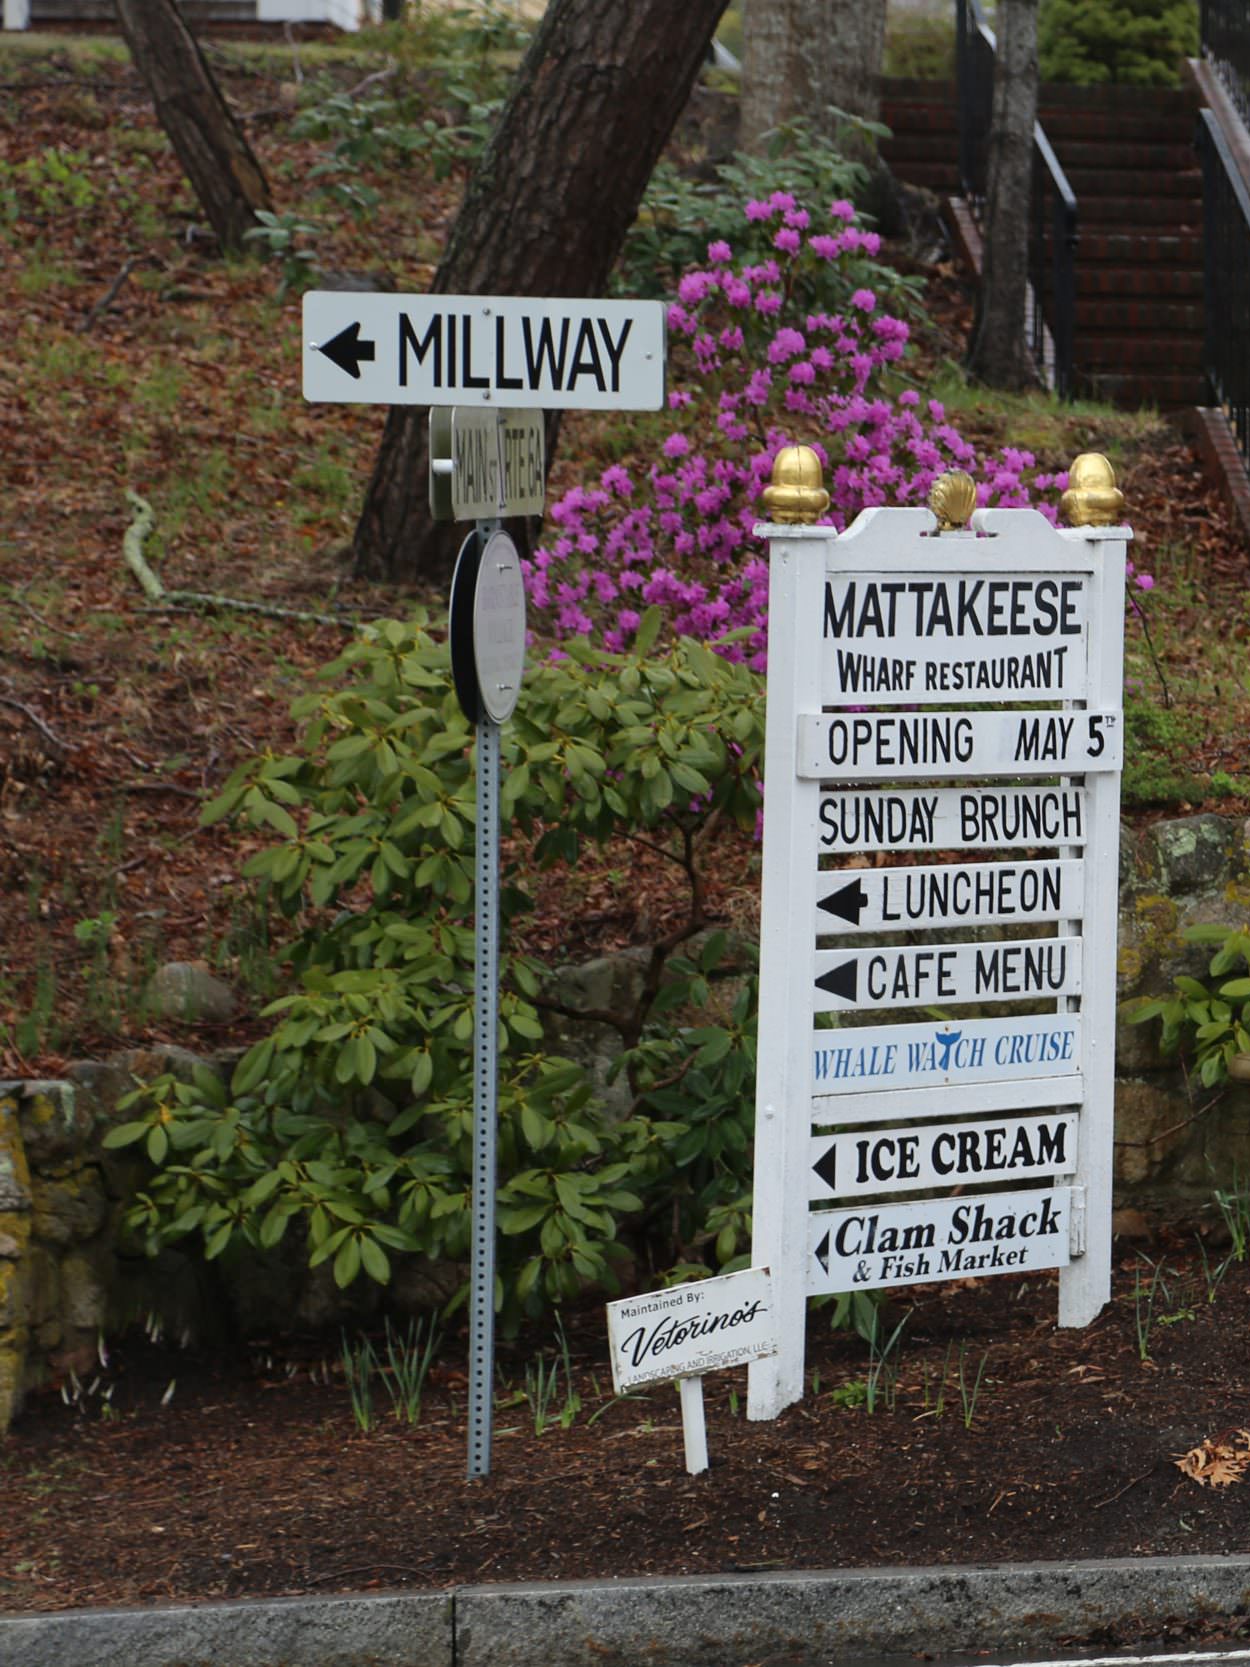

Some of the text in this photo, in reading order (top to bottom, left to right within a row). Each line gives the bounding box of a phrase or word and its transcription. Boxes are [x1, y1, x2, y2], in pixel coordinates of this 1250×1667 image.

[399, 312, 632, 392] MILLWAY
[456, 427, 487, 504] MAIN
[824, 580, 1082, 638] MATTAKEESE
[837, 646, 1068, 692] WHARF RESTAURANT
[829, 717, 973, 765] OPENING
[1014, 717, 1074, 761] MAY
[819, 791, 1081, 845] SUNDAY BRUNCH
[882, 867, 1061, 921] LUNCHEON
[868, 946, 1066, 1000] CAFE MENU
[815, 1030, 1074, 1080] WHALE WATCH CRUISE
[856, 1122, 1067, 1183] ICE CREAM
[835, 1198, 1062, 1257] Clam Shack
[852, 1245, 1028, 1283] & Fish Market
[621, 1292, 705, 1319] Maintained By:
[687, 1355, 704, 1370] AND
